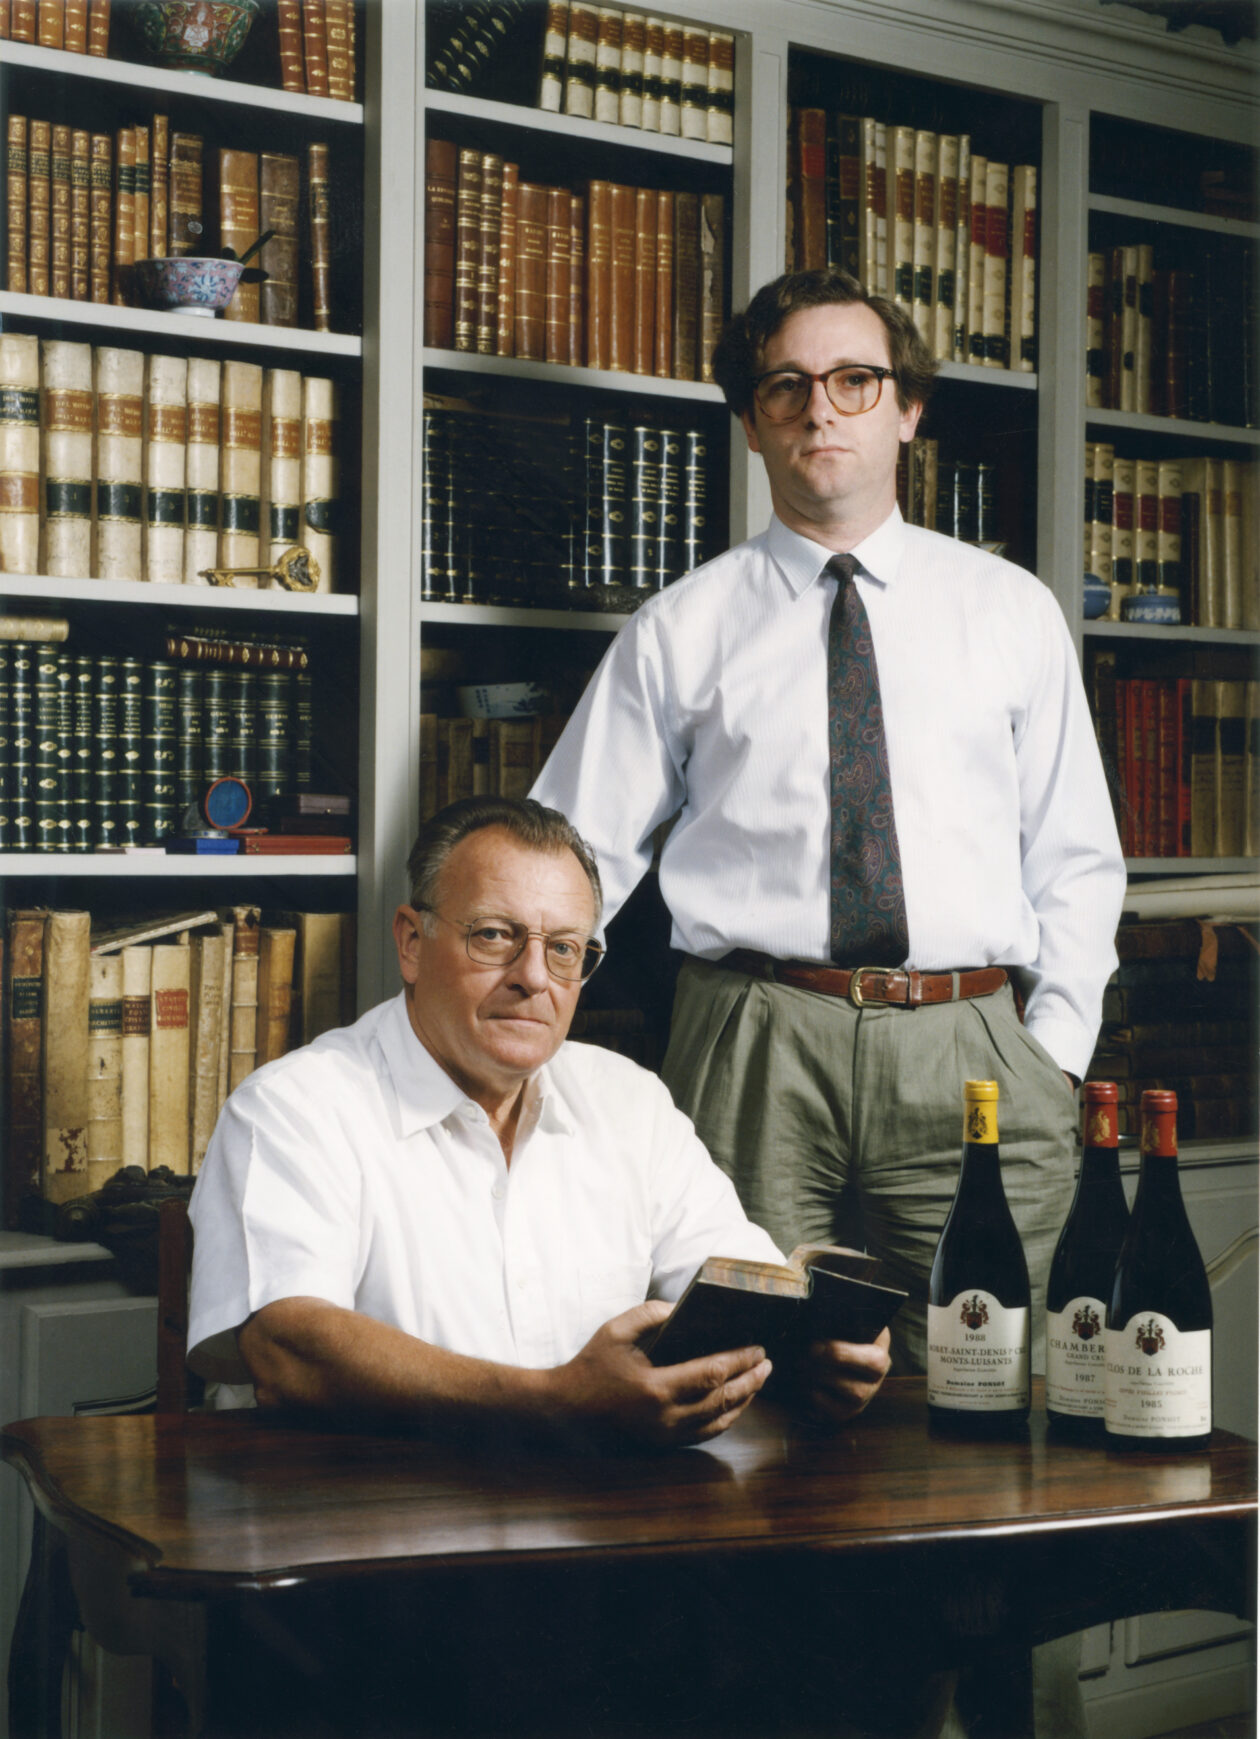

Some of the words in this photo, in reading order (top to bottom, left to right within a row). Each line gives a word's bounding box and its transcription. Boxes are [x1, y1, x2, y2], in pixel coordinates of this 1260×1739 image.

[965, 1333, 986, 1342] 1988
[940, 1356, 1012, 1365] MONTS-LUISANTS
[1066, 1352, 1089, 1360] GRAND
[1106, 1363, 1125, 1373] CLOS
[1128, 1367, 1142, 1376] DE
[1148, 1368, 1162, 1376] LA
[1168, 1366, 1203, 1376] ROCHE
[1075, 1373, 1096, 1382] 1987
[1140, 1400, 1163, 1408] 1985
